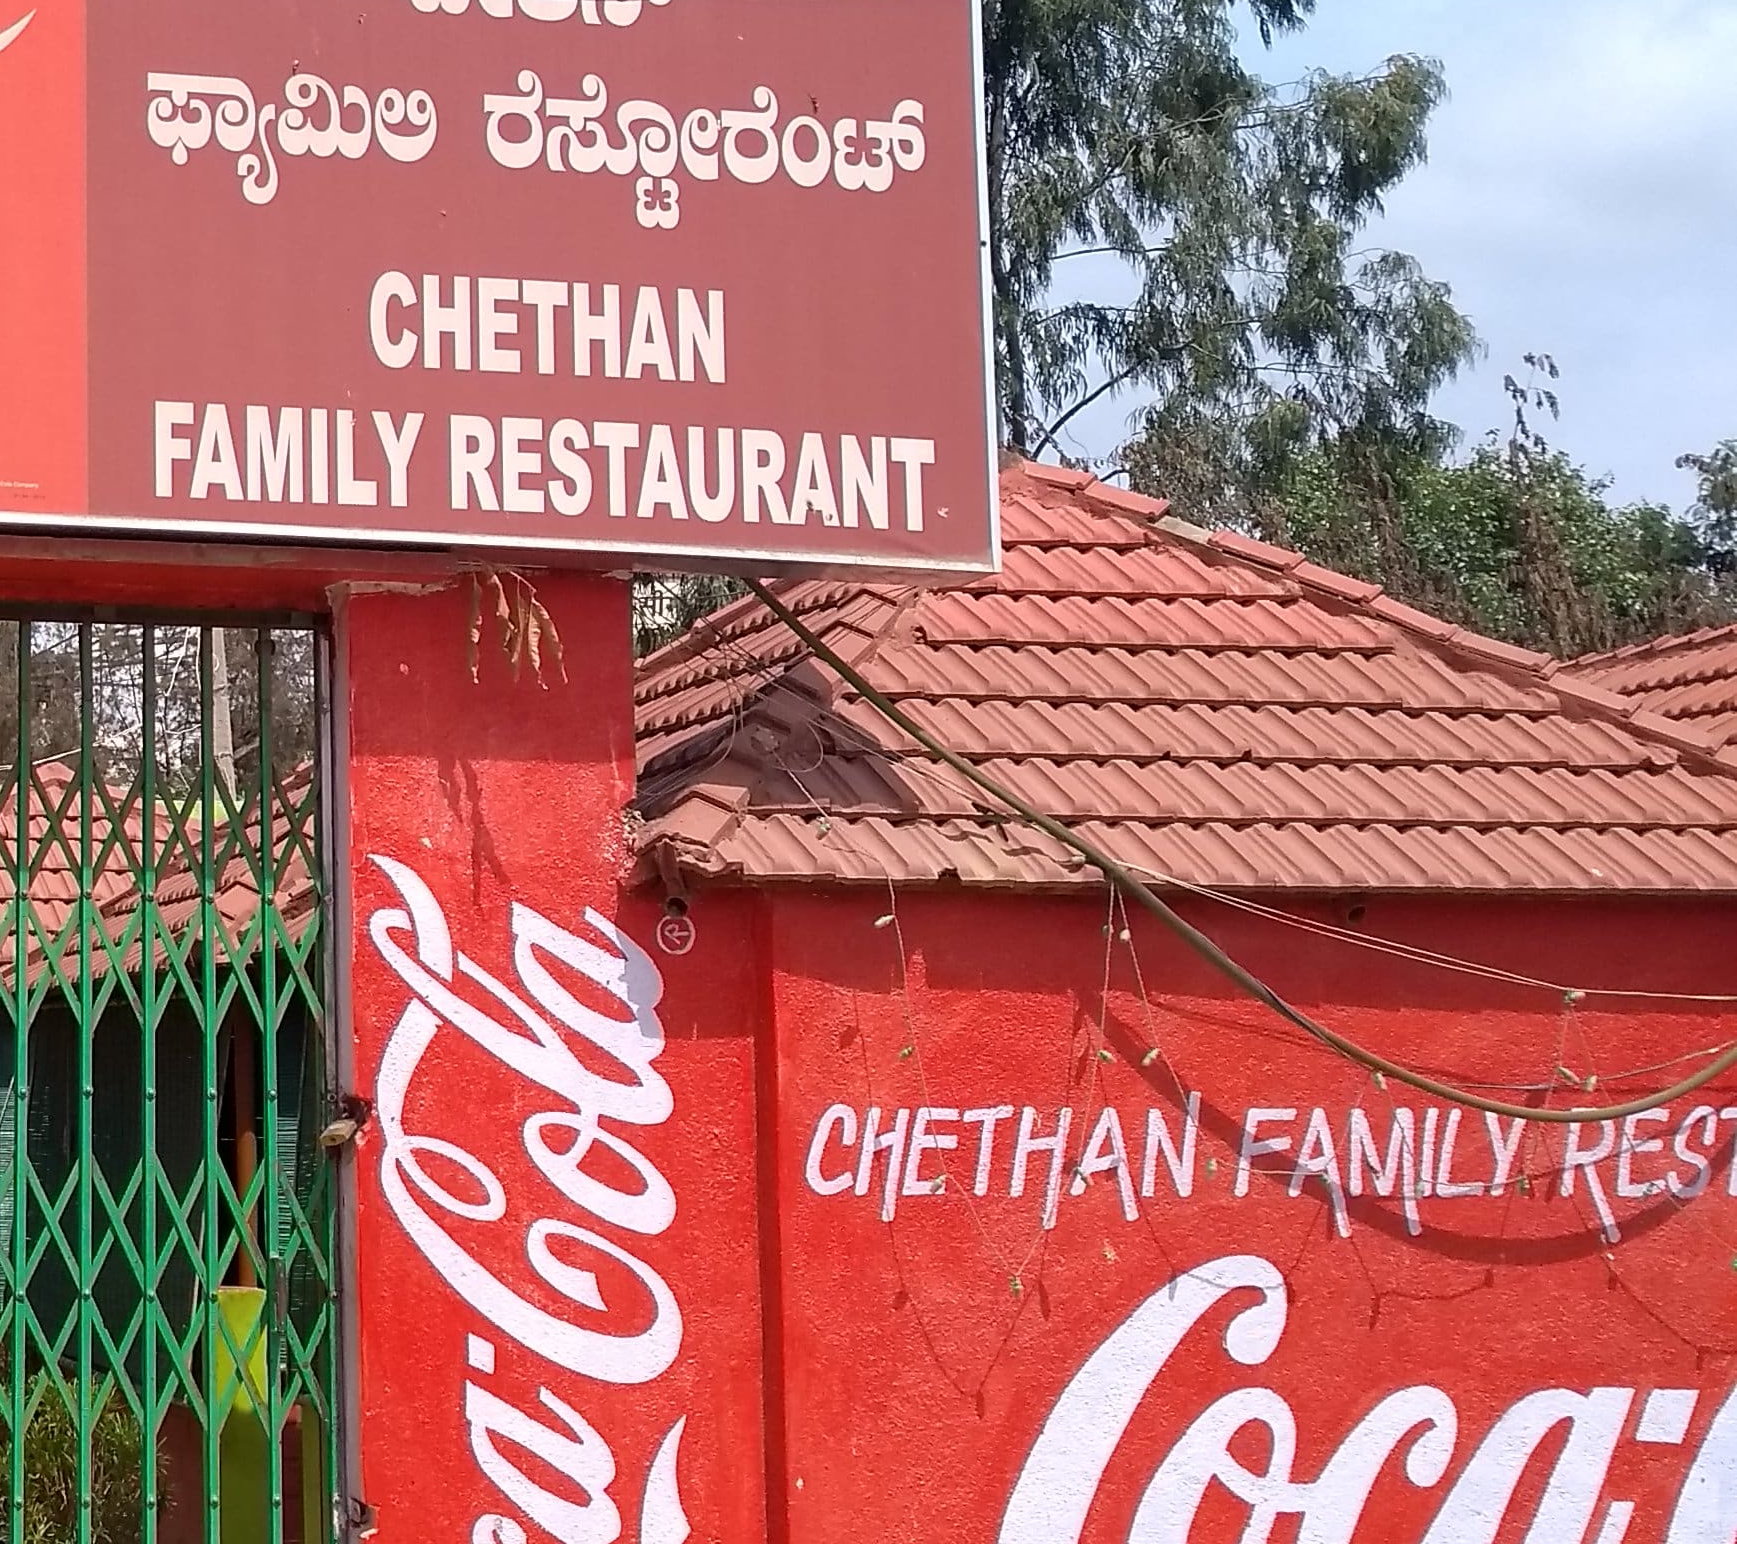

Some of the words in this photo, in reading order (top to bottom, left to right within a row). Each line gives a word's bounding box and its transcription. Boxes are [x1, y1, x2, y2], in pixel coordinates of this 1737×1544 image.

[146, 70, 439, 206] ಫ್ಯಾಮಿಲಿ
[368, 270, 727, 384] CHETHAN
[153, 399, 426, 508] FAMILY
[449, 413, 936, 533] RESTAURANT
[804, 1089, 1203, 1231] CHETHAN
[1232, 1106, 1529, 1239] FAMILY
